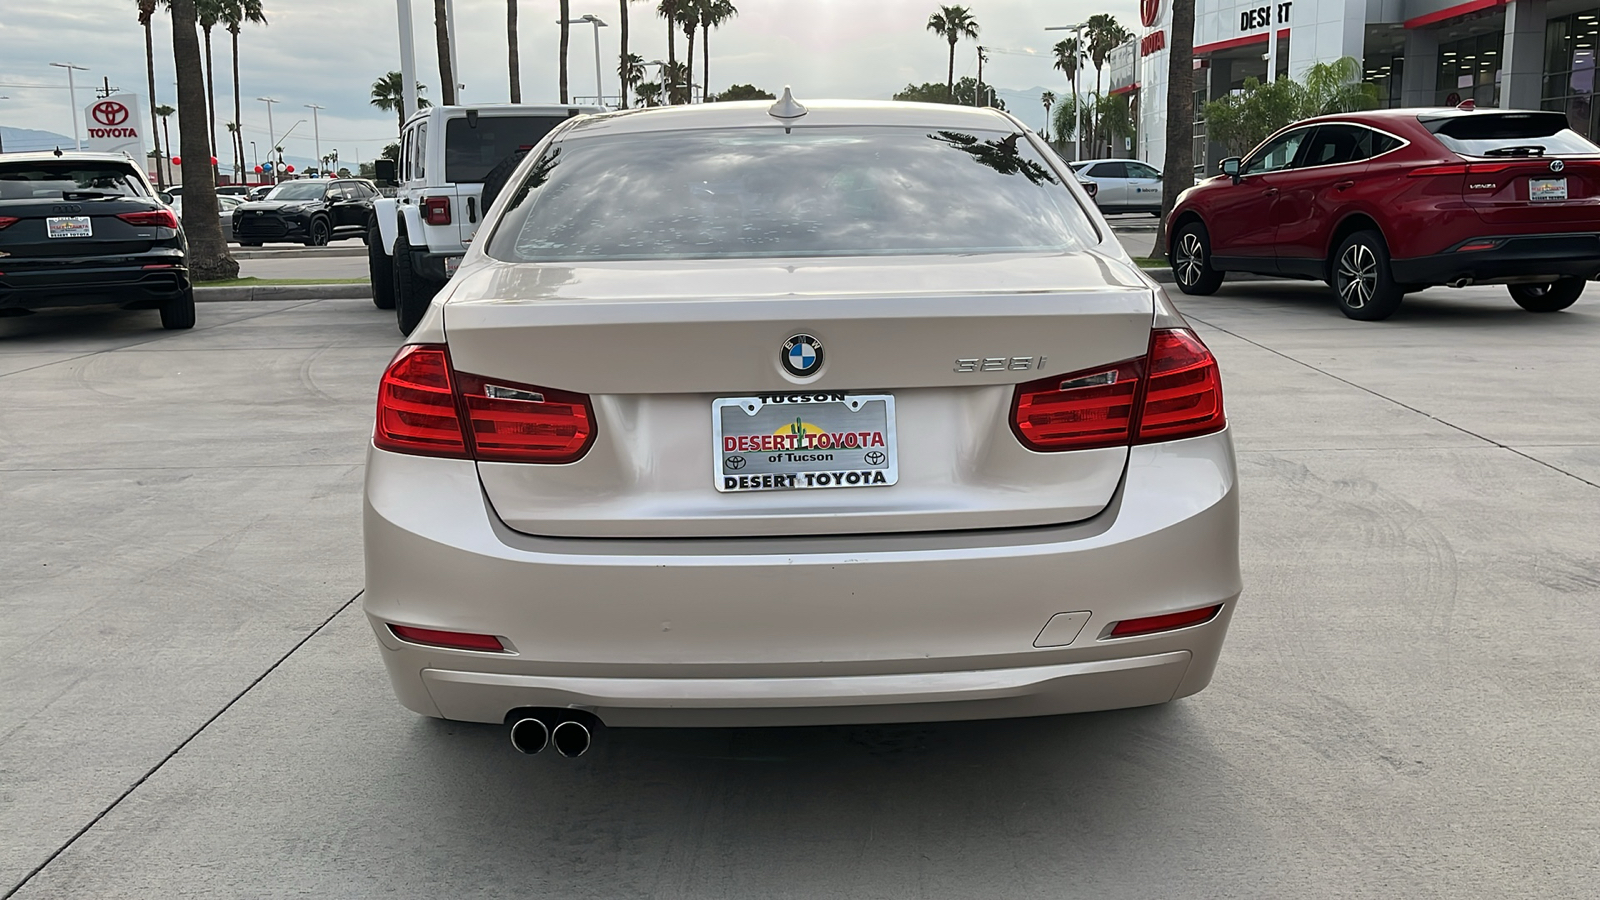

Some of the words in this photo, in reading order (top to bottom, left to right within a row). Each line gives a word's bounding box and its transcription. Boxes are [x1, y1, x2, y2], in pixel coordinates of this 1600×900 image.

[88, 128, 138, 138] TOYOTA
[784, 335, 821, 350] BMW
[953, 356, 1047, 373] 328i
[758, 393, 845, 404] TUCSON
[724, 434, 798, 451] DESERT
[804, 432, 885, 449] TOYOTA
[768, 453, 783, 463] of
[785, 452, 834, 462] Tucson
[724, 474, 797, 489] DESERT
[805, 471, 886, 486] TOYOTA
